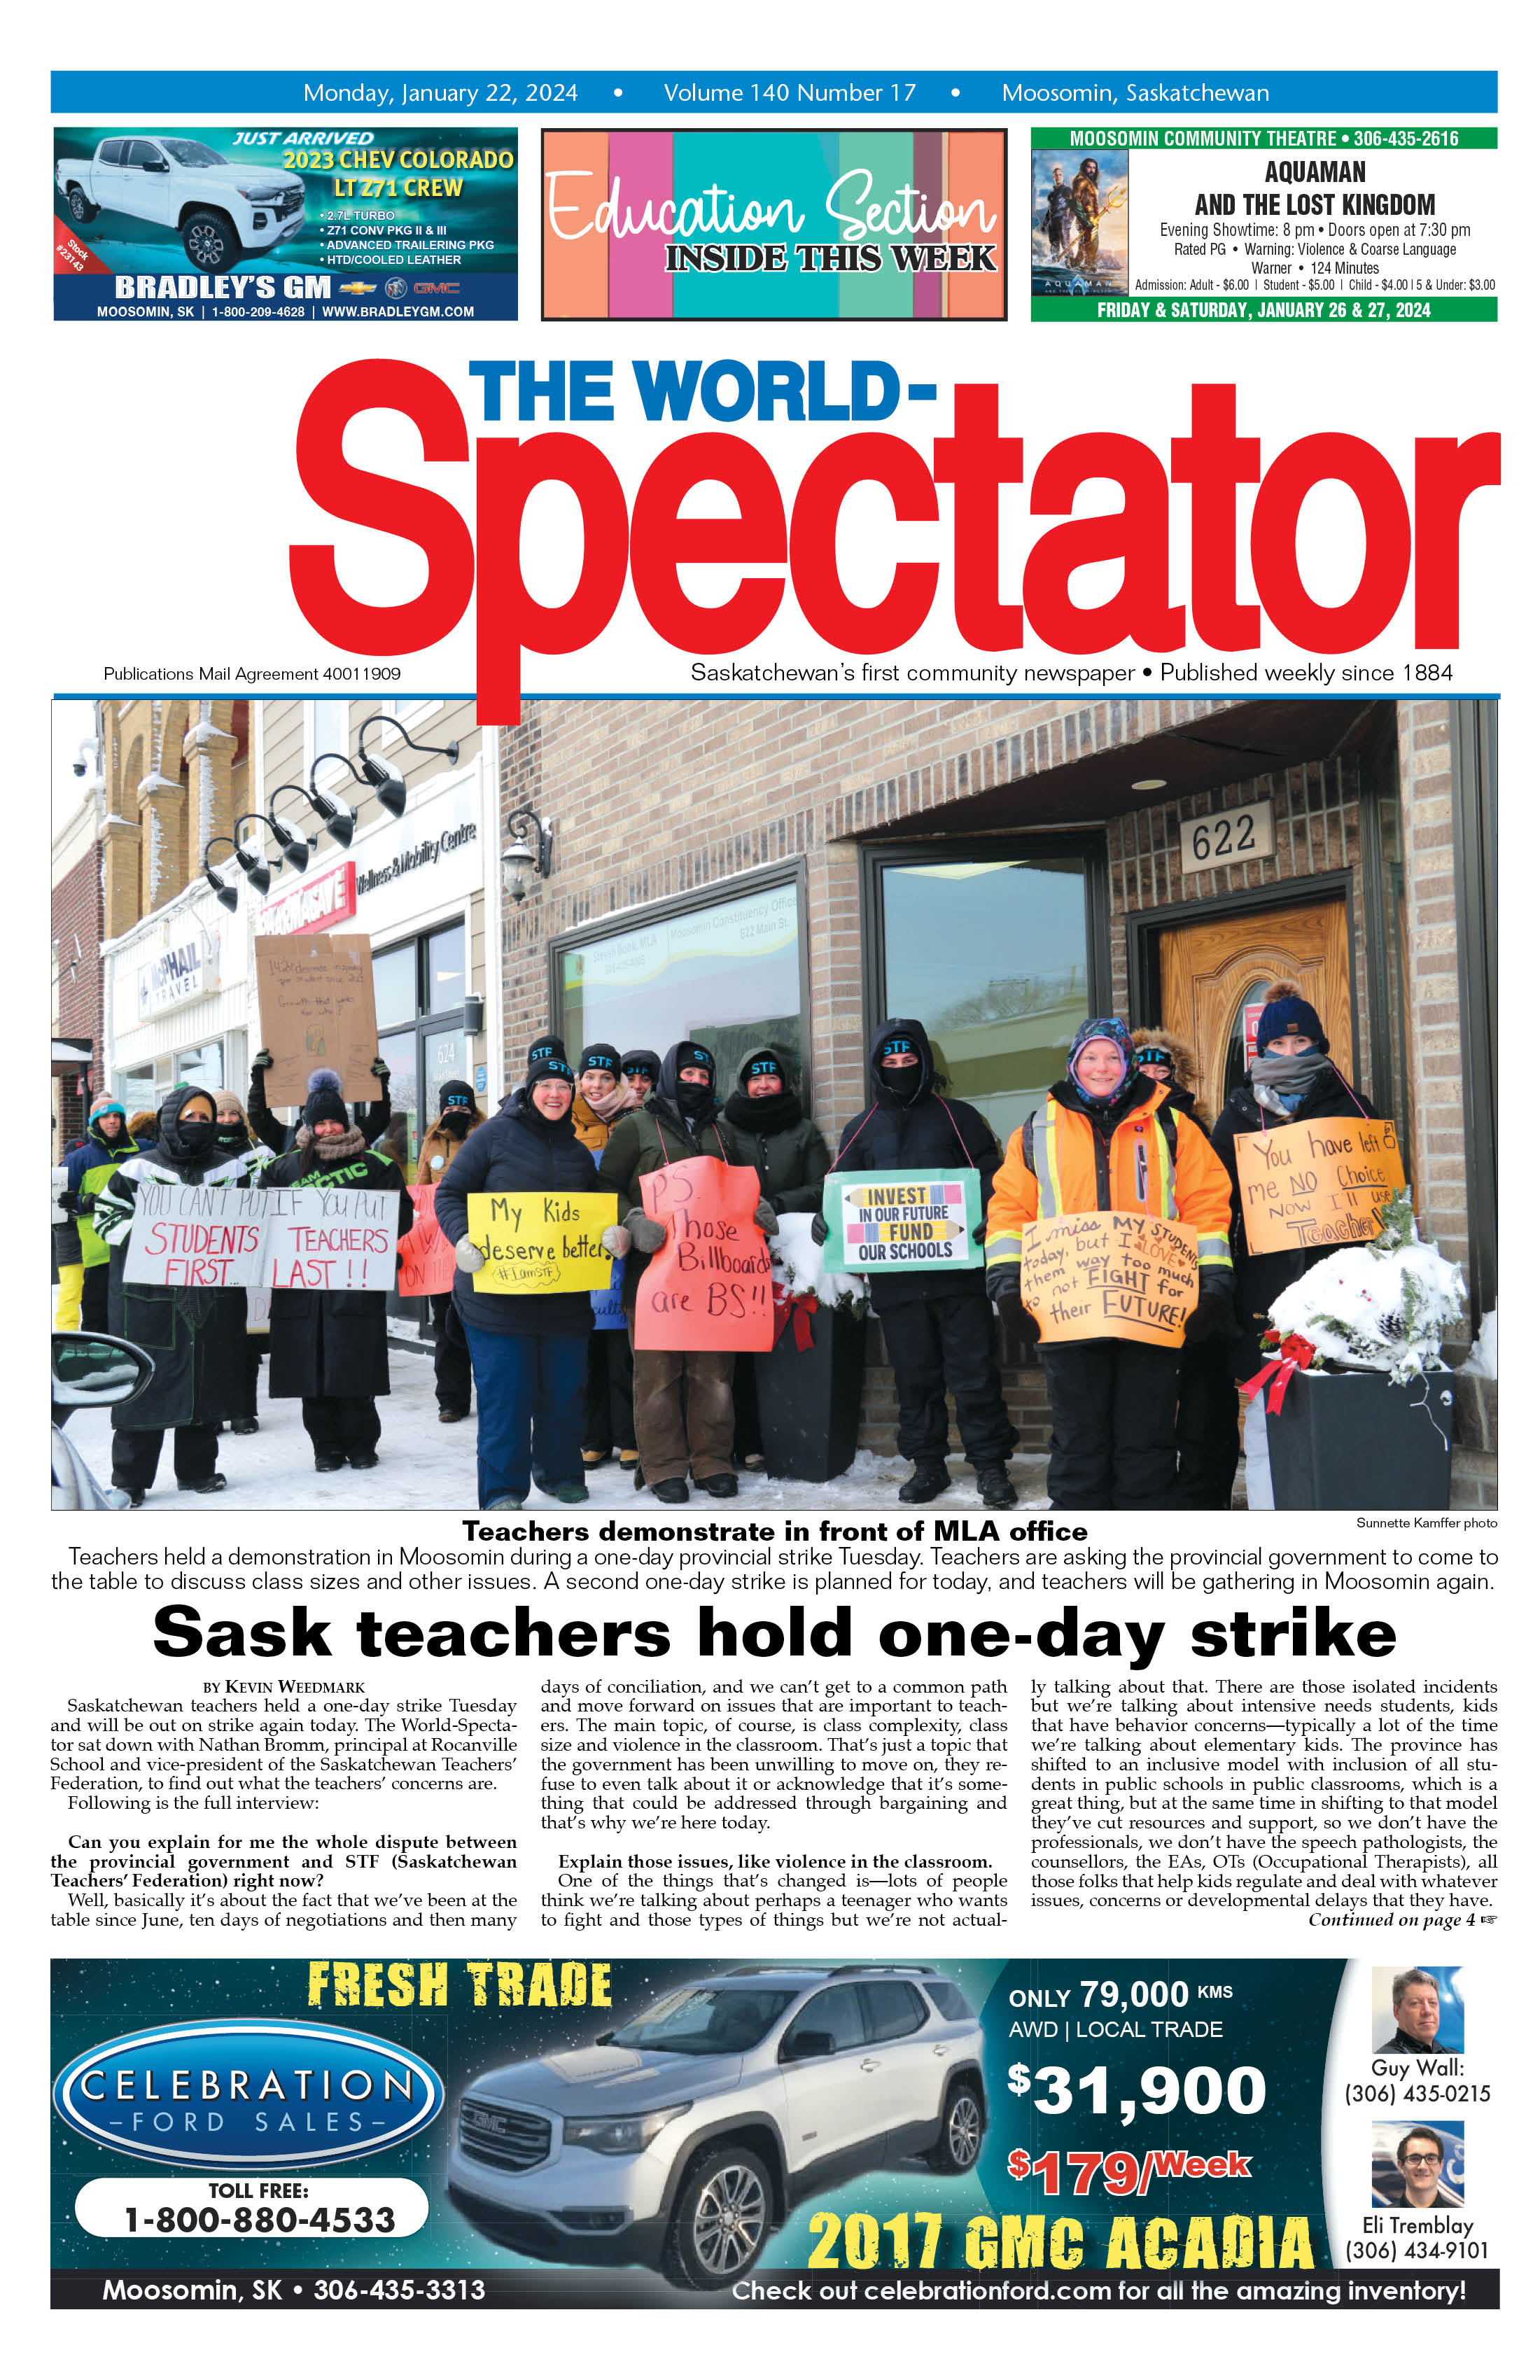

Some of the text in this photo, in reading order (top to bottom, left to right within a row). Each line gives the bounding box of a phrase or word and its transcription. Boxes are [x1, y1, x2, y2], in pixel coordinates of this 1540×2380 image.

[305, 83, 577, 106] Monday, January 22, 2024
[1004, 83, 1268, 104] Moosomin, Saskatchewan
[233, 132, 373, 144] JUST ARRIVED
[1071, 131, 1458, 146] MOOSOMIN COMMUNITY THEATRE 306-435-2616
[284, 151, 513, 169] 2023 CHEV COLORADO
[1266, 161, 1365, 183] AQUAMAN
[328, 210, 394, 220] 2.7L TURBO
[545, 168, 997, 241] Education Section
[56, 244, 84, 272] #23143
[68, 239, 88, 261] Stock
[667, 245, 996, 271] INSIDE THIS WEEK
[1252, 262, 1379, 274] Warner 124 Minutes
[284, 276, 330, 298] GM
[414, 283, 460, 294] GMC
[98, 307, 473, 318] MOOSOMIN, SK 1-800-209-4628 WWW.BRADLEYGM.COM
[470, 361, 613, 420] THE
[288, 358, 1502, 726] Spectator
[1194, 814, 1255, 860] 622
[356, 822, 477, 895] Wellness & Mobility Centre
[713, 904, 769, 929] Constituency
[438, 1042, 455, 1064] 624
[532, 1047, 552, 1060] STF
[884, 1040, 911, 1055] STF
[588, 1056, 613, 1069] STF
[751, 1061, 777, 1075] STF
[448, 1095, 469, 1105] STF
[1253, 1130, 1381, 1170] You have left
[868, 1186, 926, 1205] INVEST
[1248, 1165, 1387, 1205] me NO Choice
[1371, 1191, 1392, 1203] use
[139, 1189, 275, 1219] YOU CAN'T PUT
[270, 1189, 303, 1216] IF
[491, 1196, 580, 1233] My Kids
[860, 1205, 948, 1223] IN OUR FUTURE
[665, 1207, 740, 1241] Those
[890, 1222, 933, 1241] FUND
[145, 1222, 260, 1255] STUDENTS
[288, 1226, 388, 1254] TEACHERS
[480, 1233, 556, 1261] deserve
[859, 1241, 953, 1261] OUR SCHOOLS
[1025, 1216, 1198, 1270] I miss MY STUDENTS
[678, 1241, 771, 1274] Billboards
[1024, 1233, 1178, 1272] today, but I LOVE
[273, 1258, 337, 1289] LAST
[1025, 1253, 1194, 1292] them way too much
[652, 1291, 694, 1314] are
[1026, 1268, 1184, 1312] to not FIGHT for
[1050, 1290, 1186, 1328] their FUTURE!
[1357, 1518, 1497, 1531] Sunnette Kamffer photo
[154, 1604, 1396, 1670] Sask teachers hold one-day strike
[1310, 1912, 1475, 1931] Continued on page 4
[309, 1961, 612, 2007] FRESH TRADE
[1372, 2058, 1463, 2080] Guy Wall:
[80, 2068, 413, 2099] CELEBRATION
[1008, 2062, 1265, 2126] $31,900
[134, 2112, 361, 2132] FORD SALES
[127, 2207, 395, 2232] 1-800-880-4533
[808, 2212, 1314, 2271] 2017 GMC ACADIA
